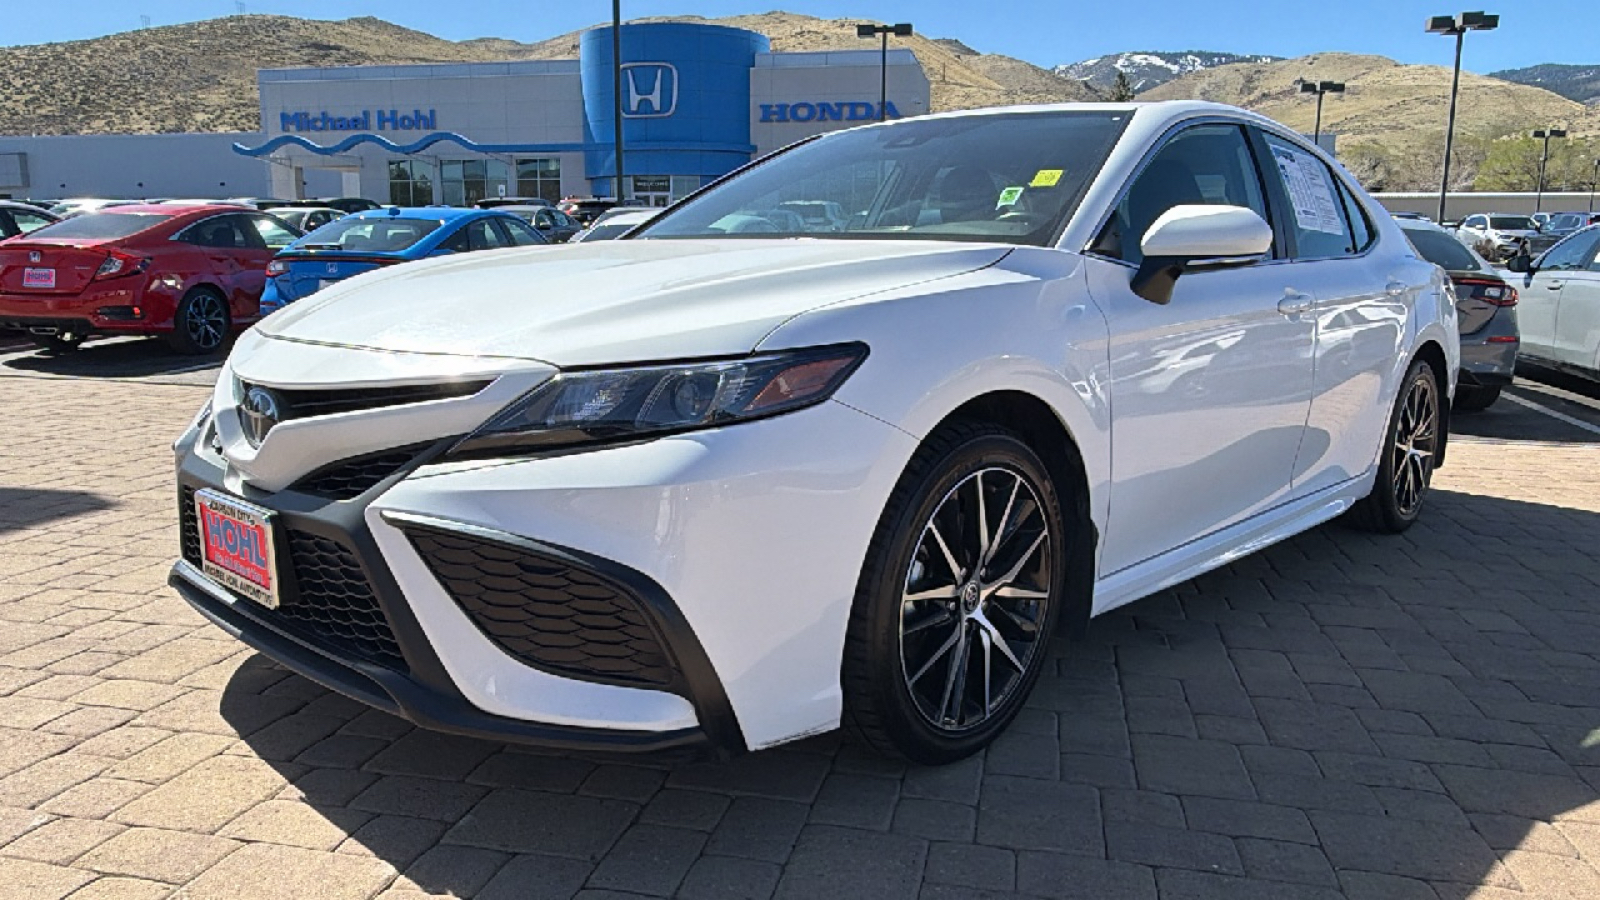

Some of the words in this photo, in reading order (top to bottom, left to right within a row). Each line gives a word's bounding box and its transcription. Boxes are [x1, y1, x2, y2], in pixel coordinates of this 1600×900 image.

[279, 110, 370, 132] Michael
[376, 109, 436, 130] Hohl
[759, 101, 902, 123] HONDA
[206, 513, 266, 569] HOHL
